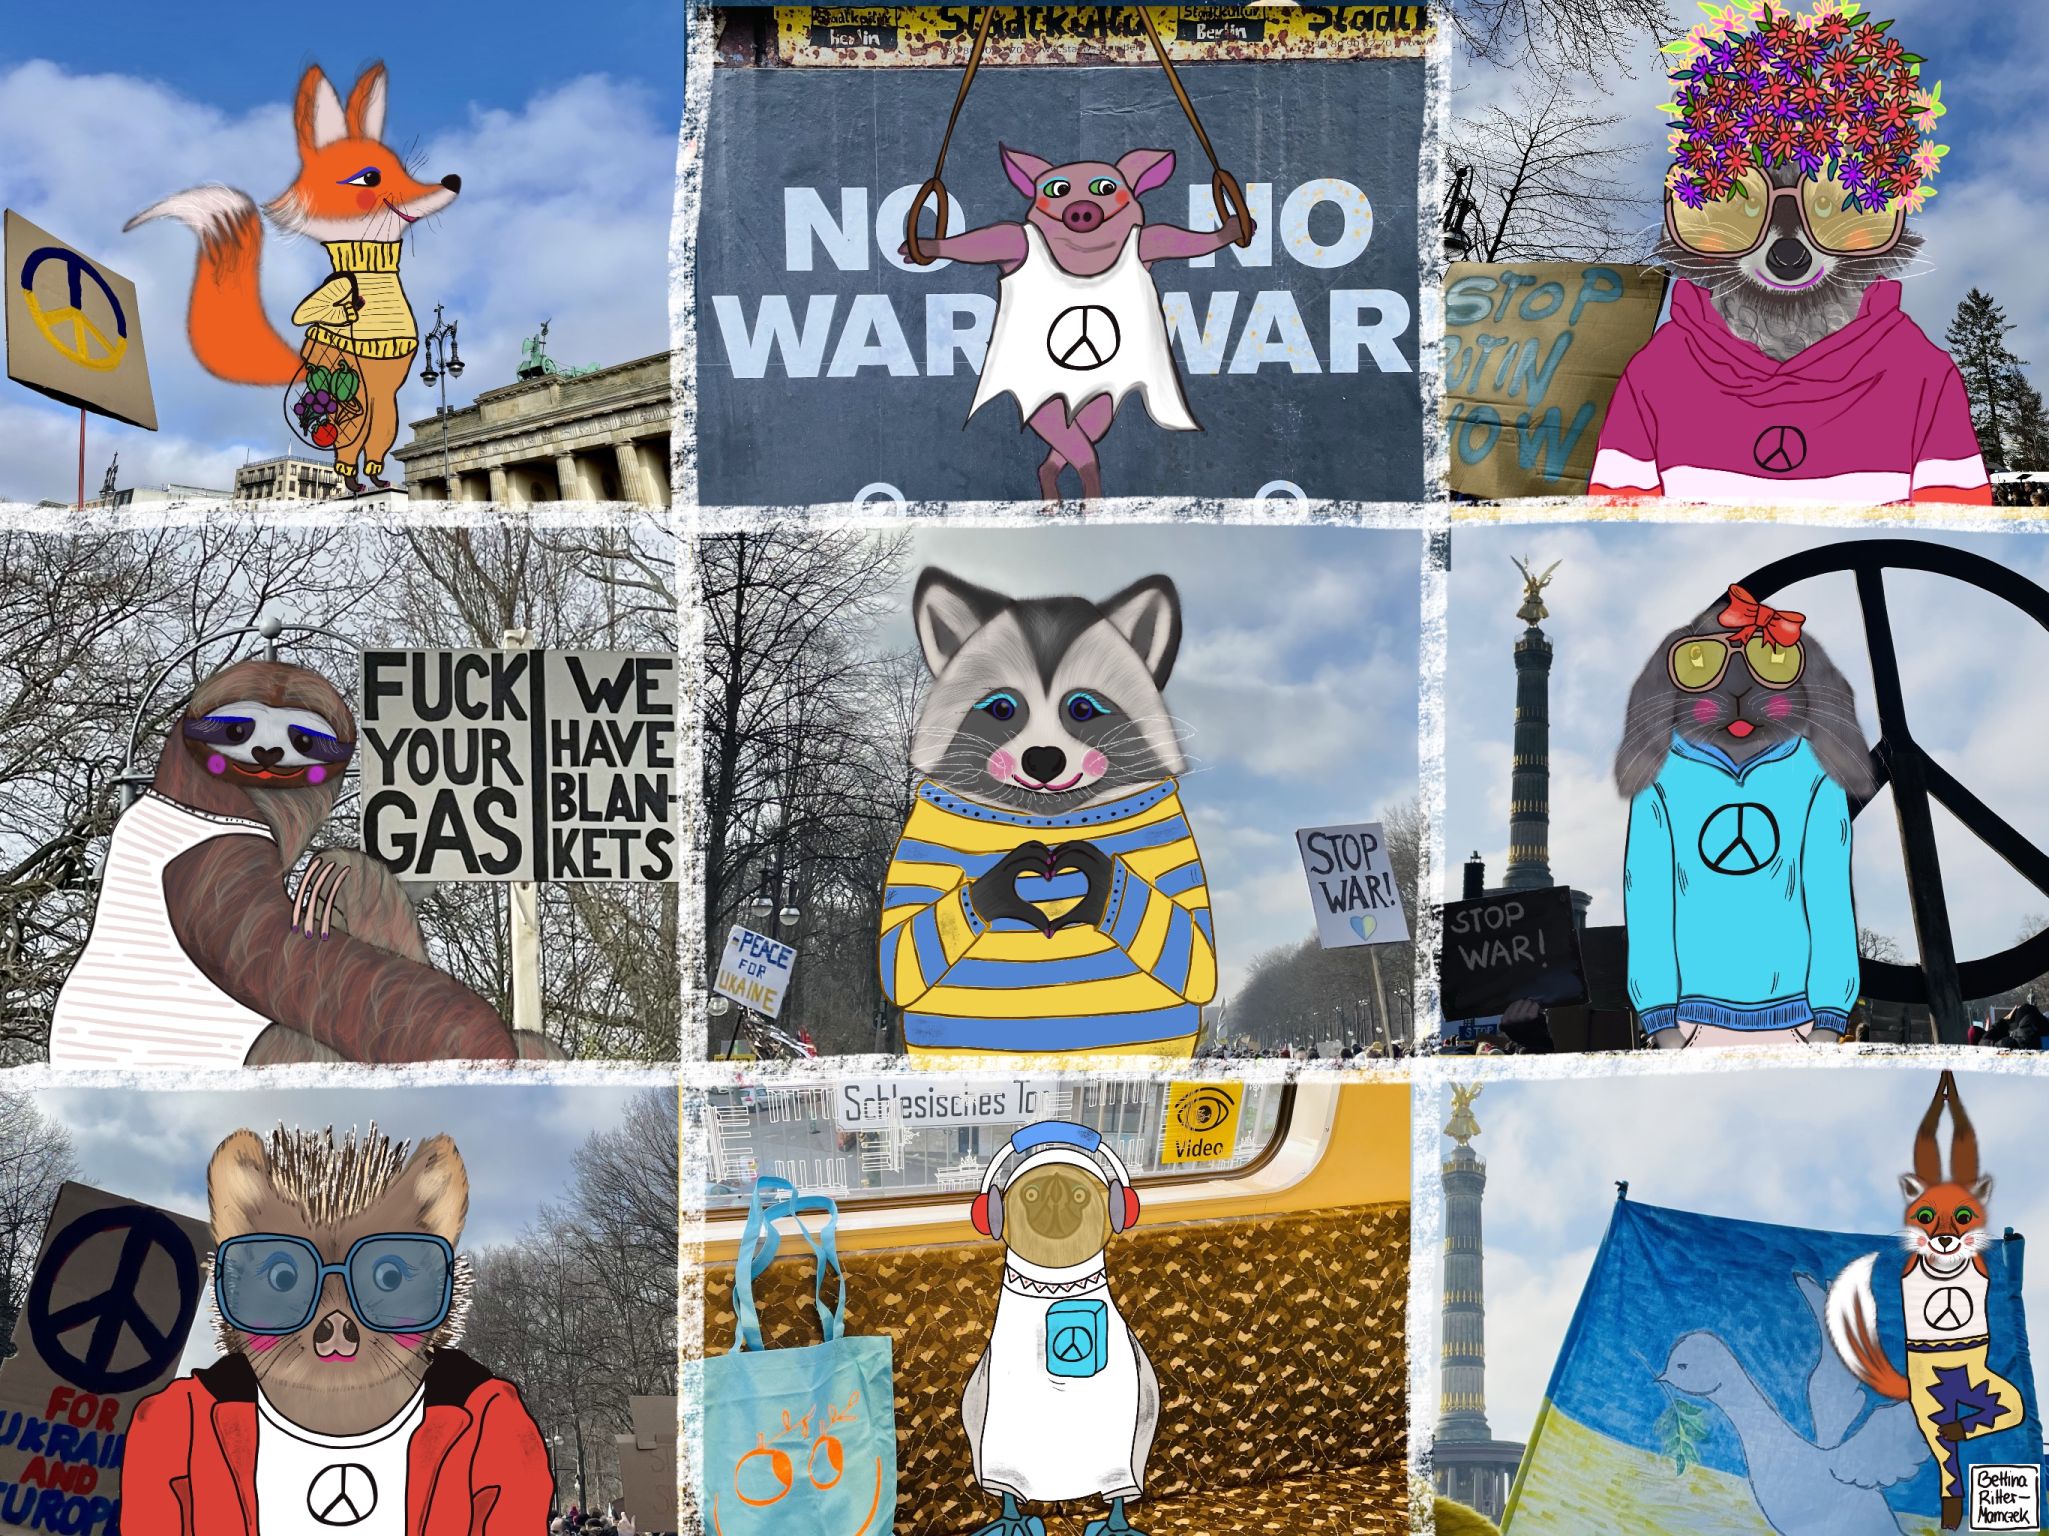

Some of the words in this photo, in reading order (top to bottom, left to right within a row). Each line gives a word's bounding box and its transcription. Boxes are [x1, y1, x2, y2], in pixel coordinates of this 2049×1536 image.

[784, 183, 966, 273] NO
[1189, 178, 1373, 268] NO
[1446, 267, 1624, 326] STOP
[711, 293, 997, 378] WAR
[1163, 289, 1413, 374] WAR
[1447, 400, 1597, 484] OW
[364, 652, 528, 721] FUCK
[565, 656, 673, 715] WE
[362, 728, 524, 786] YOUR
[551, 719, 674, 768] HAVE
[551, 772, 678, 822] BLAN-
[363, 786, 523, 876] GAS
[553, 827, 675, 880] KETS
[1307, 831, 1378, 875] STOP
[1318, 872, 1395, 914] WAR!
[1450, 902, 1525, 934] STOP
[738, 959, 766, 979] FOR
[1458, 929, 1548, 971] WAR!
[844, 1084, 1005, 1122] Schlesisches
[45, 1385, 120, 1433] FOR
[19, 1455, 98, 1495] AND
